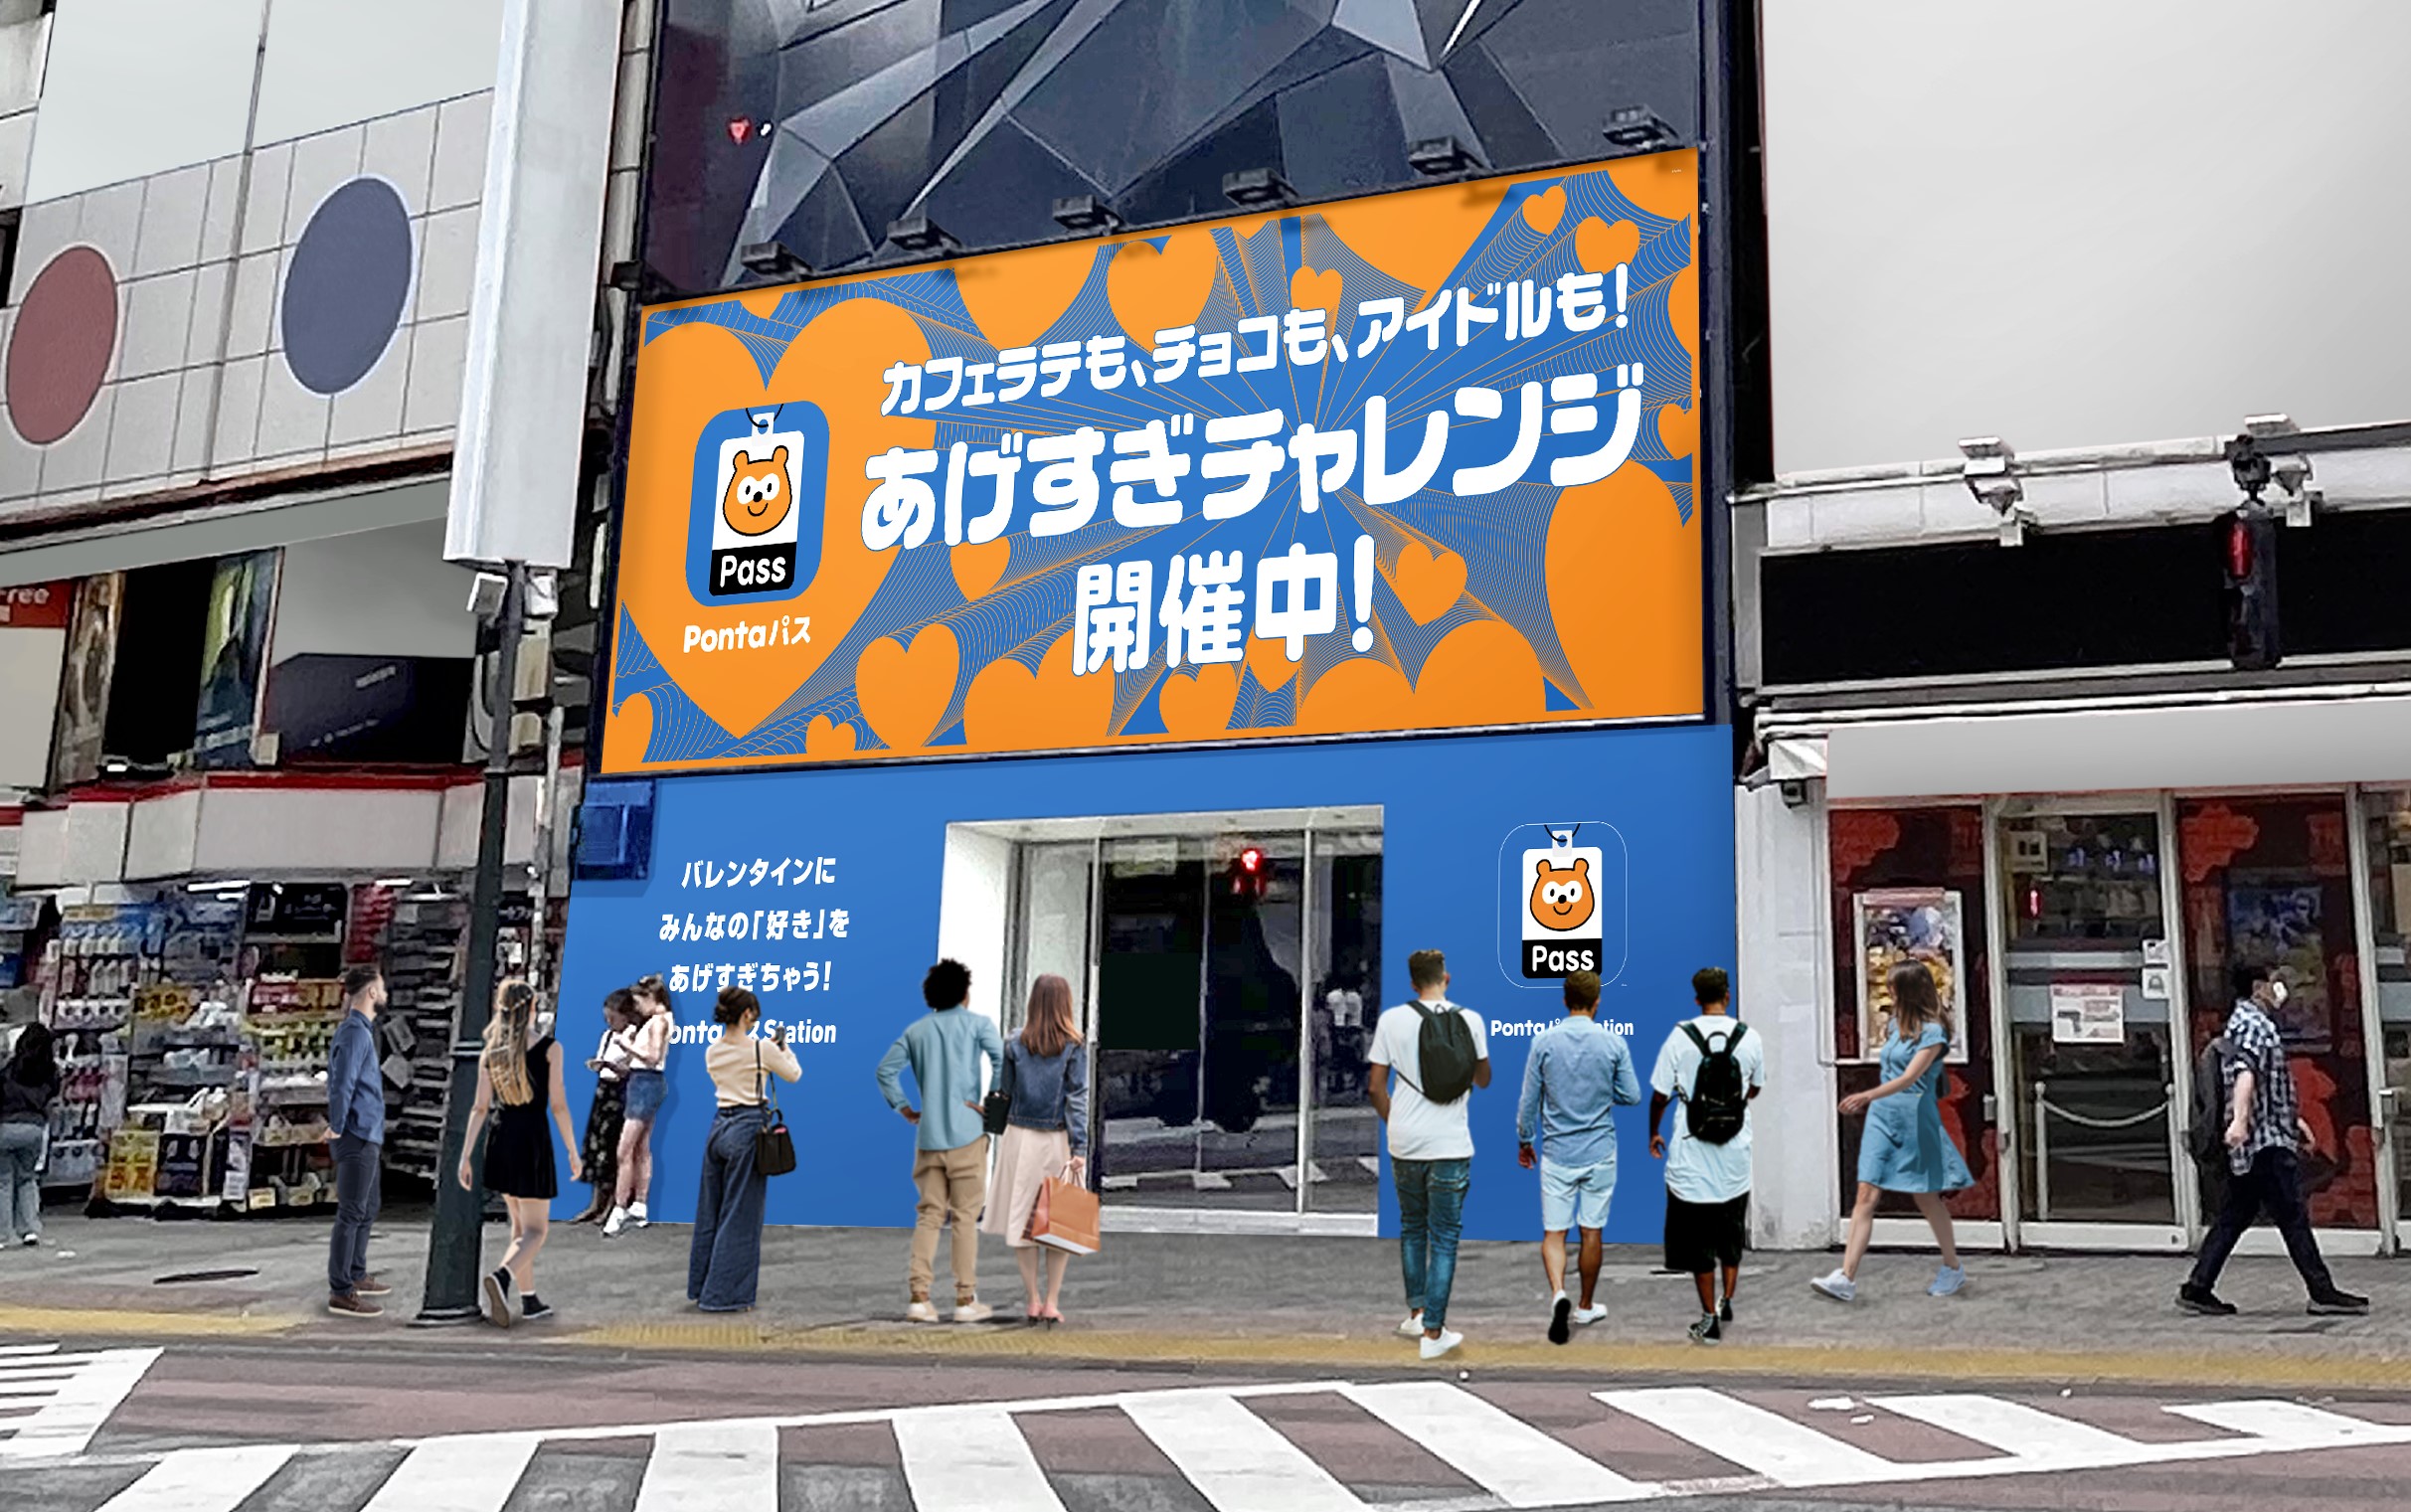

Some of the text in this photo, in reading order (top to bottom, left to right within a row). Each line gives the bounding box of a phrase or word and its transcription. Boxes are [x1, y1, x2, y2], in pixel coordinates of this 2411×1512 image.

[879, 262, 1630, 418] カフェラテも、チョコも、アイドルも!
[860, 362, 1645, 552] あげすぎチャレンジ
[720, 555, 786, 588] Pass
[0, 588, 50, 604] ree
[1072, 534, 1376, 677] 開催中!
[683, 614, 811, 653] Pontaパス
[681, 856, 837, 890] バレンタインに
[659, 908, 850, 942] みんなの「好き」を
[1532, 945, 1595, 972] Pass
[668, 960, 832, 993] あげすぎちゃう!
